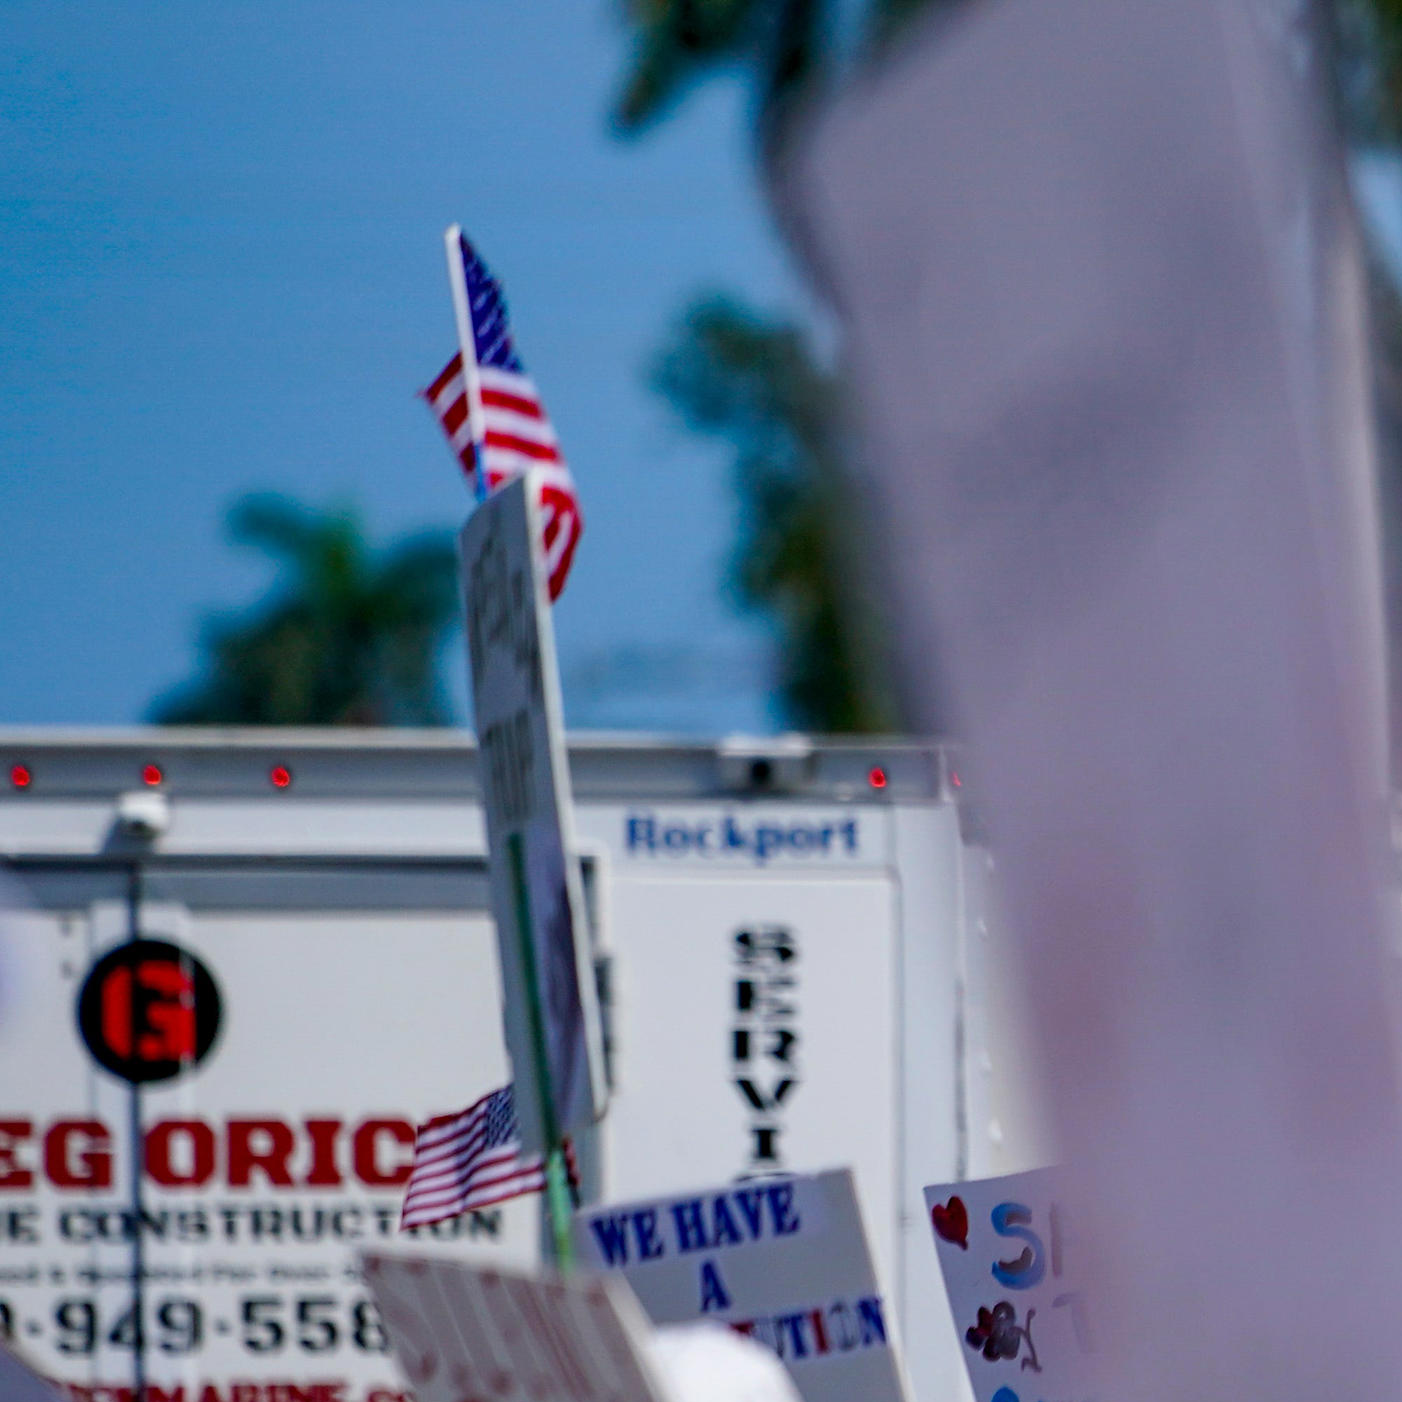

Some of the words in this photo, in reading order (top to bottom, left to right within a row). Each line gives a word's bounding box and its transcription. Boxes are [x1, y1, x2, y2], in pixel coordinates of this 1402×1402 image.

[626, 811, 858, 862] Rockport
[731, 924, 798, 1180] SERVI
[590, 1209, 664, 1268] WE
[671, 1182, 800, 1253] HAVE
[700, 1258, 731, 1314] A
